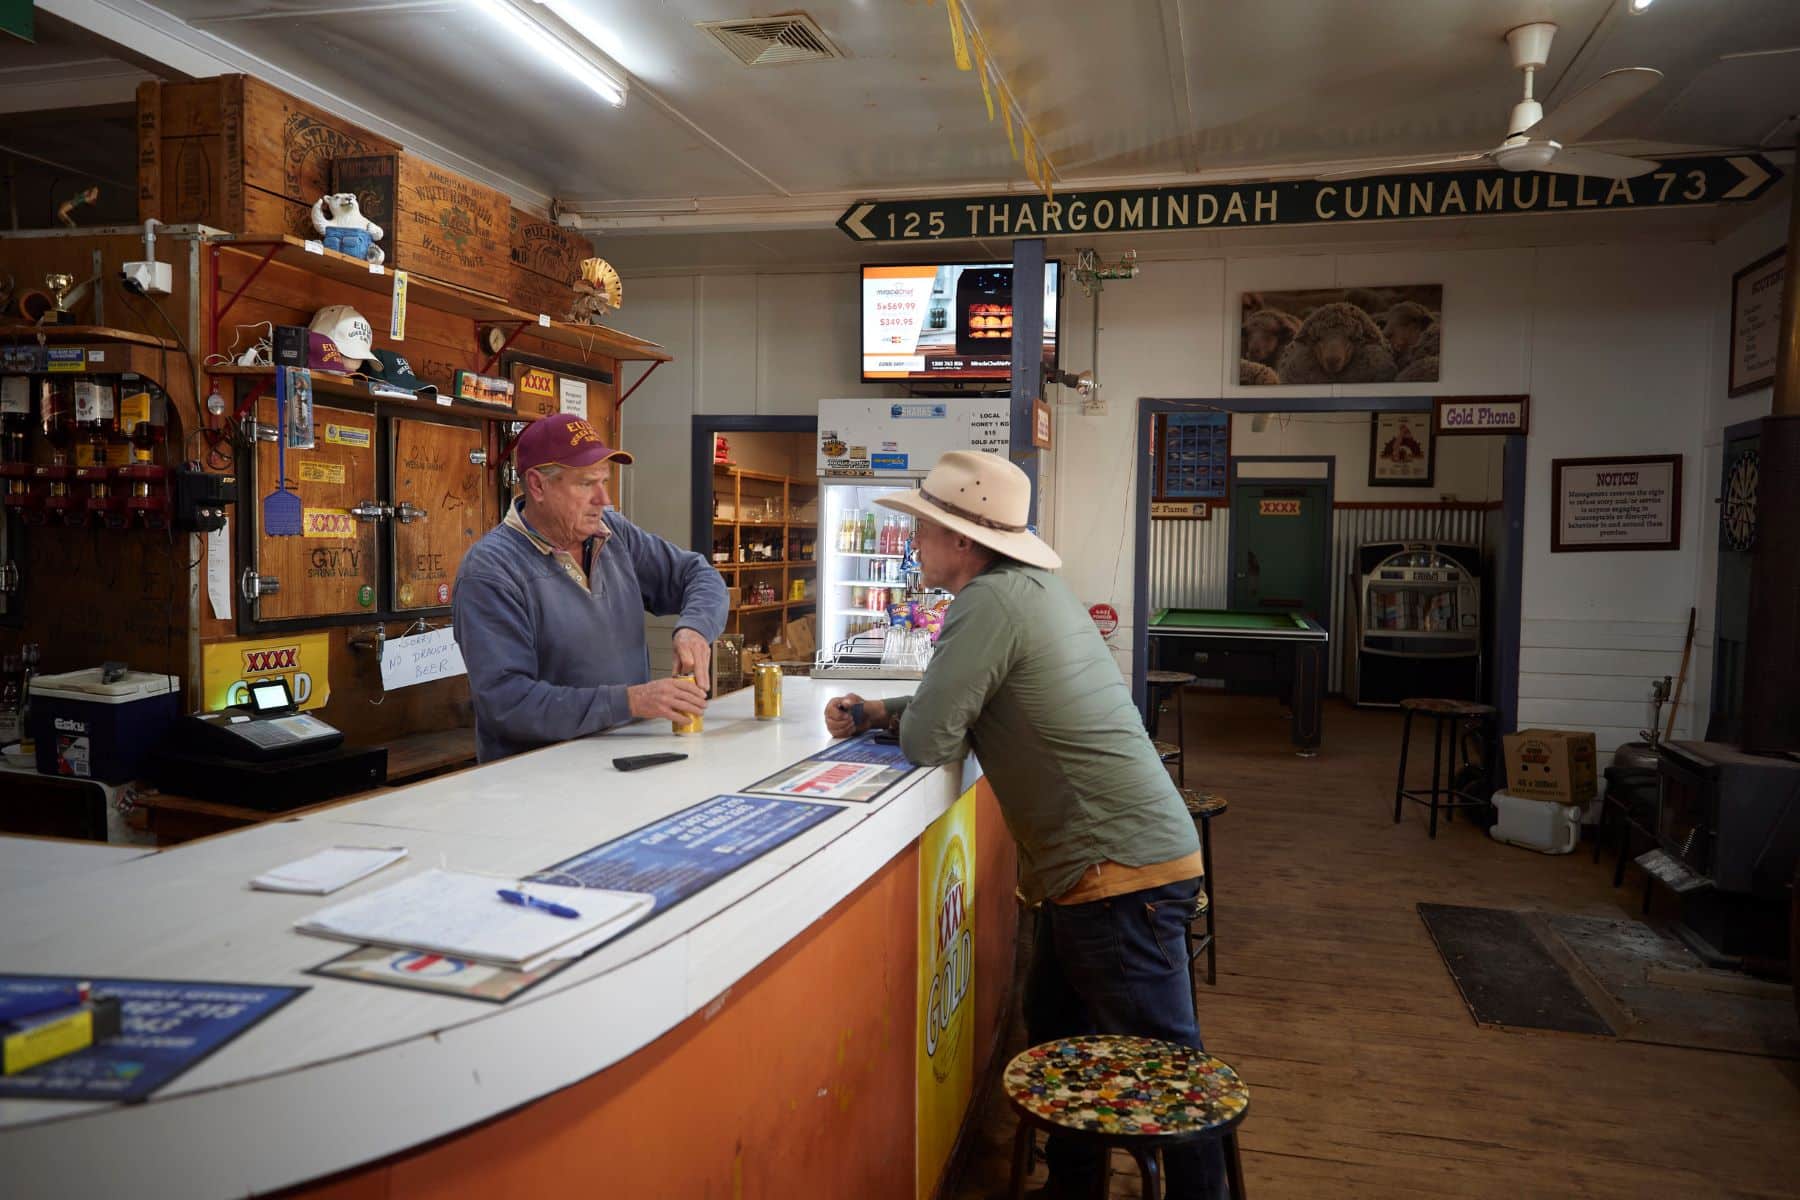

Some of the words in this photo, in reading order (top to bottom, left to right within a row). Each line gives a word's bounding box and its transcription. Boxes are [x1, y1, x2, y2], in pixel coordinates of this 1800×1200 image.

[887, 211, 946, 238] 125
[965, 189, 1278, 235] THARGOMINDAH
[1314, 175, 1636, 219] CUNNAMULLA
[1652, 168, 1708, 202] 73
[880, 318, 913, 326] $349.95
[525, 374, 551, 393] XXXX
[1447, 408, 1473, 425] Gold
[1477, 407, 1516, 425] Phone
[1596, 471, 1639, 487] NOTICE!
[1568, 489, 1608, 498] Management
[1648, 489, 1665, 497] right
[1163, 505, 1189, 513] Fame
[1263, 502, 1297, 513] XXXX
[309, 513, 352, 532] XXXX
[338, 567, 360, 577] VALE
[399, 633, 433, 648] SORRY
[246, 648, 297, 673] XXXX
[389, 656, 402, 671] NO
[414, 643, 456, 663] DRAUGHT
[415, 659, 448, 679] BEER
[226, 671, 313, 707] GD
[54, 717, 86, 732] Esky
[937, 883, 966, 962] XXXX
[926, 928, 972, 1058] GOLD
